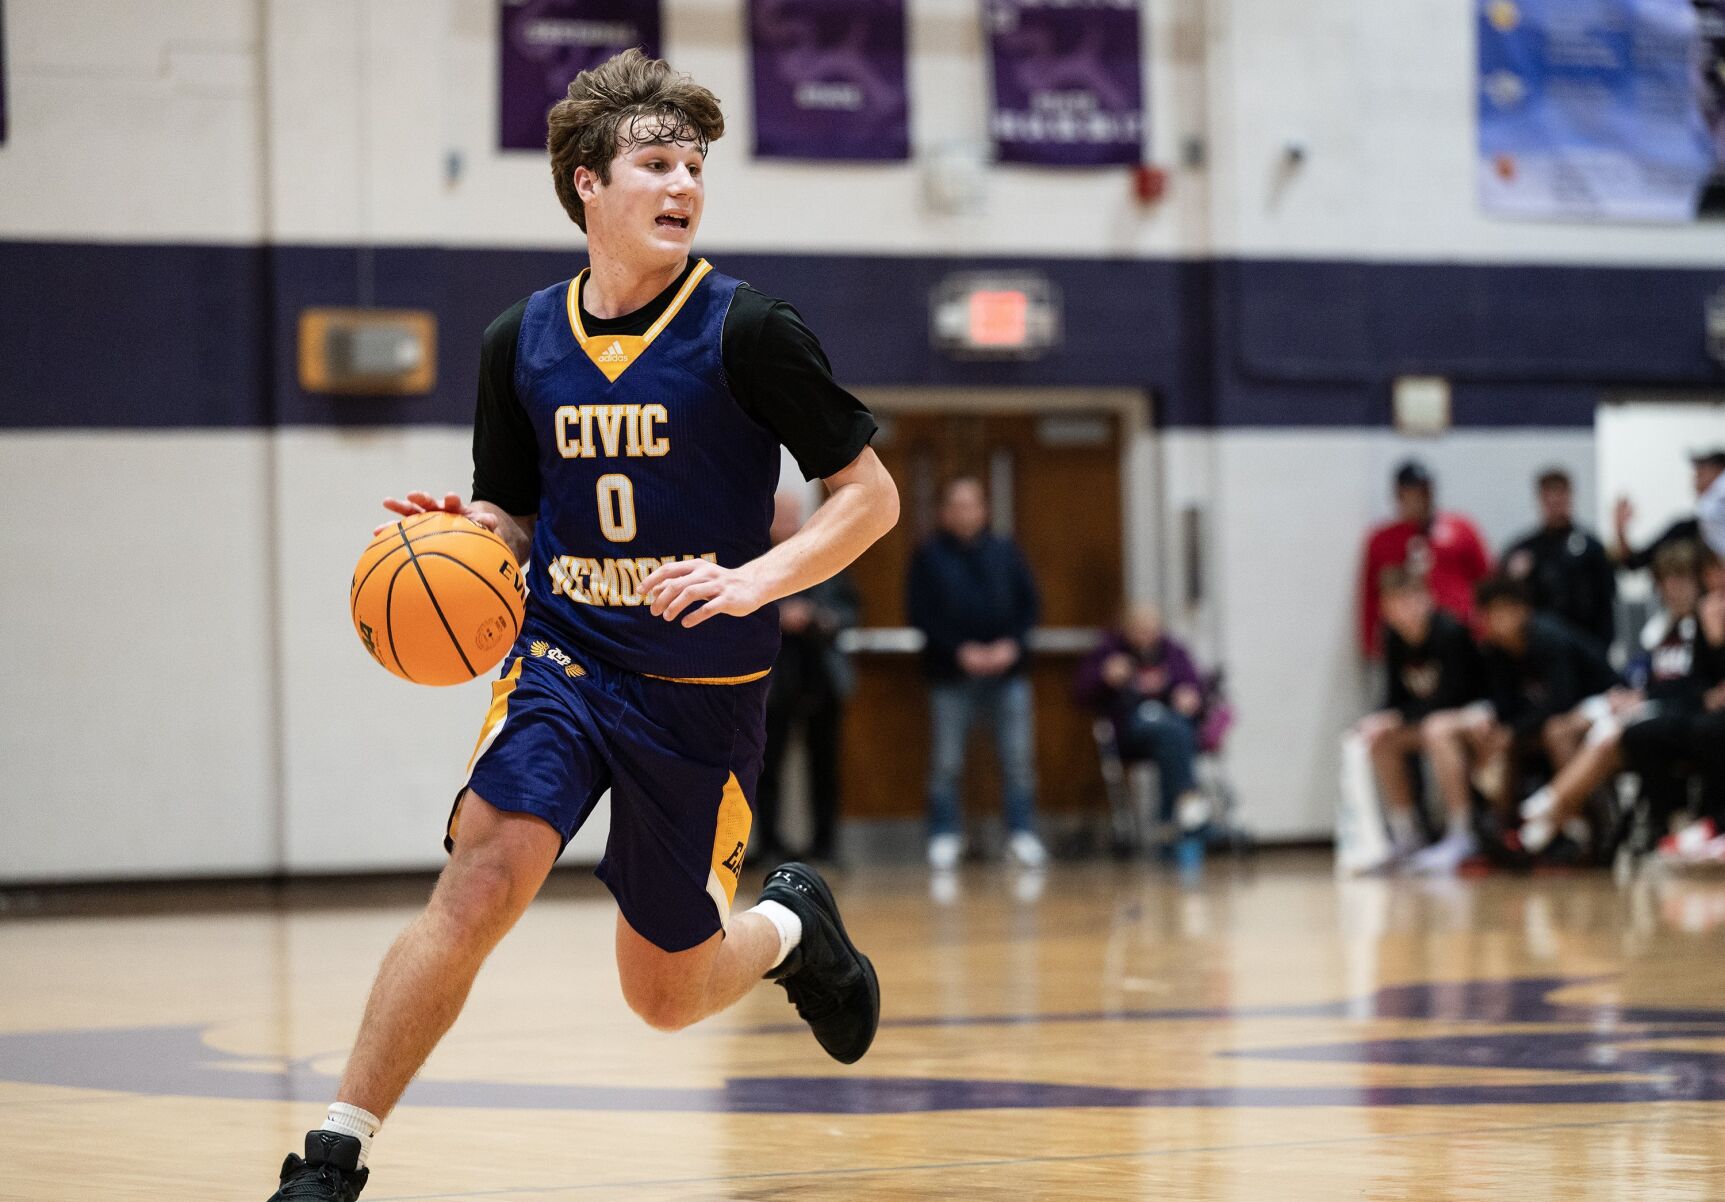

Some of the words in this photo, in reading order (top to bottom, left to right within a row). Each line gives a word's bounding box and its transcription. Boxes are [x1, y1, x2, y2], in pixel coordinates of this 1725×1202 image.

[598, 354, 628, 362] adidas
[555, 404, 670, 458] CIVIC
[596, 474, 637, 542] 0
[548, 552, 717, 606] MEMOR
